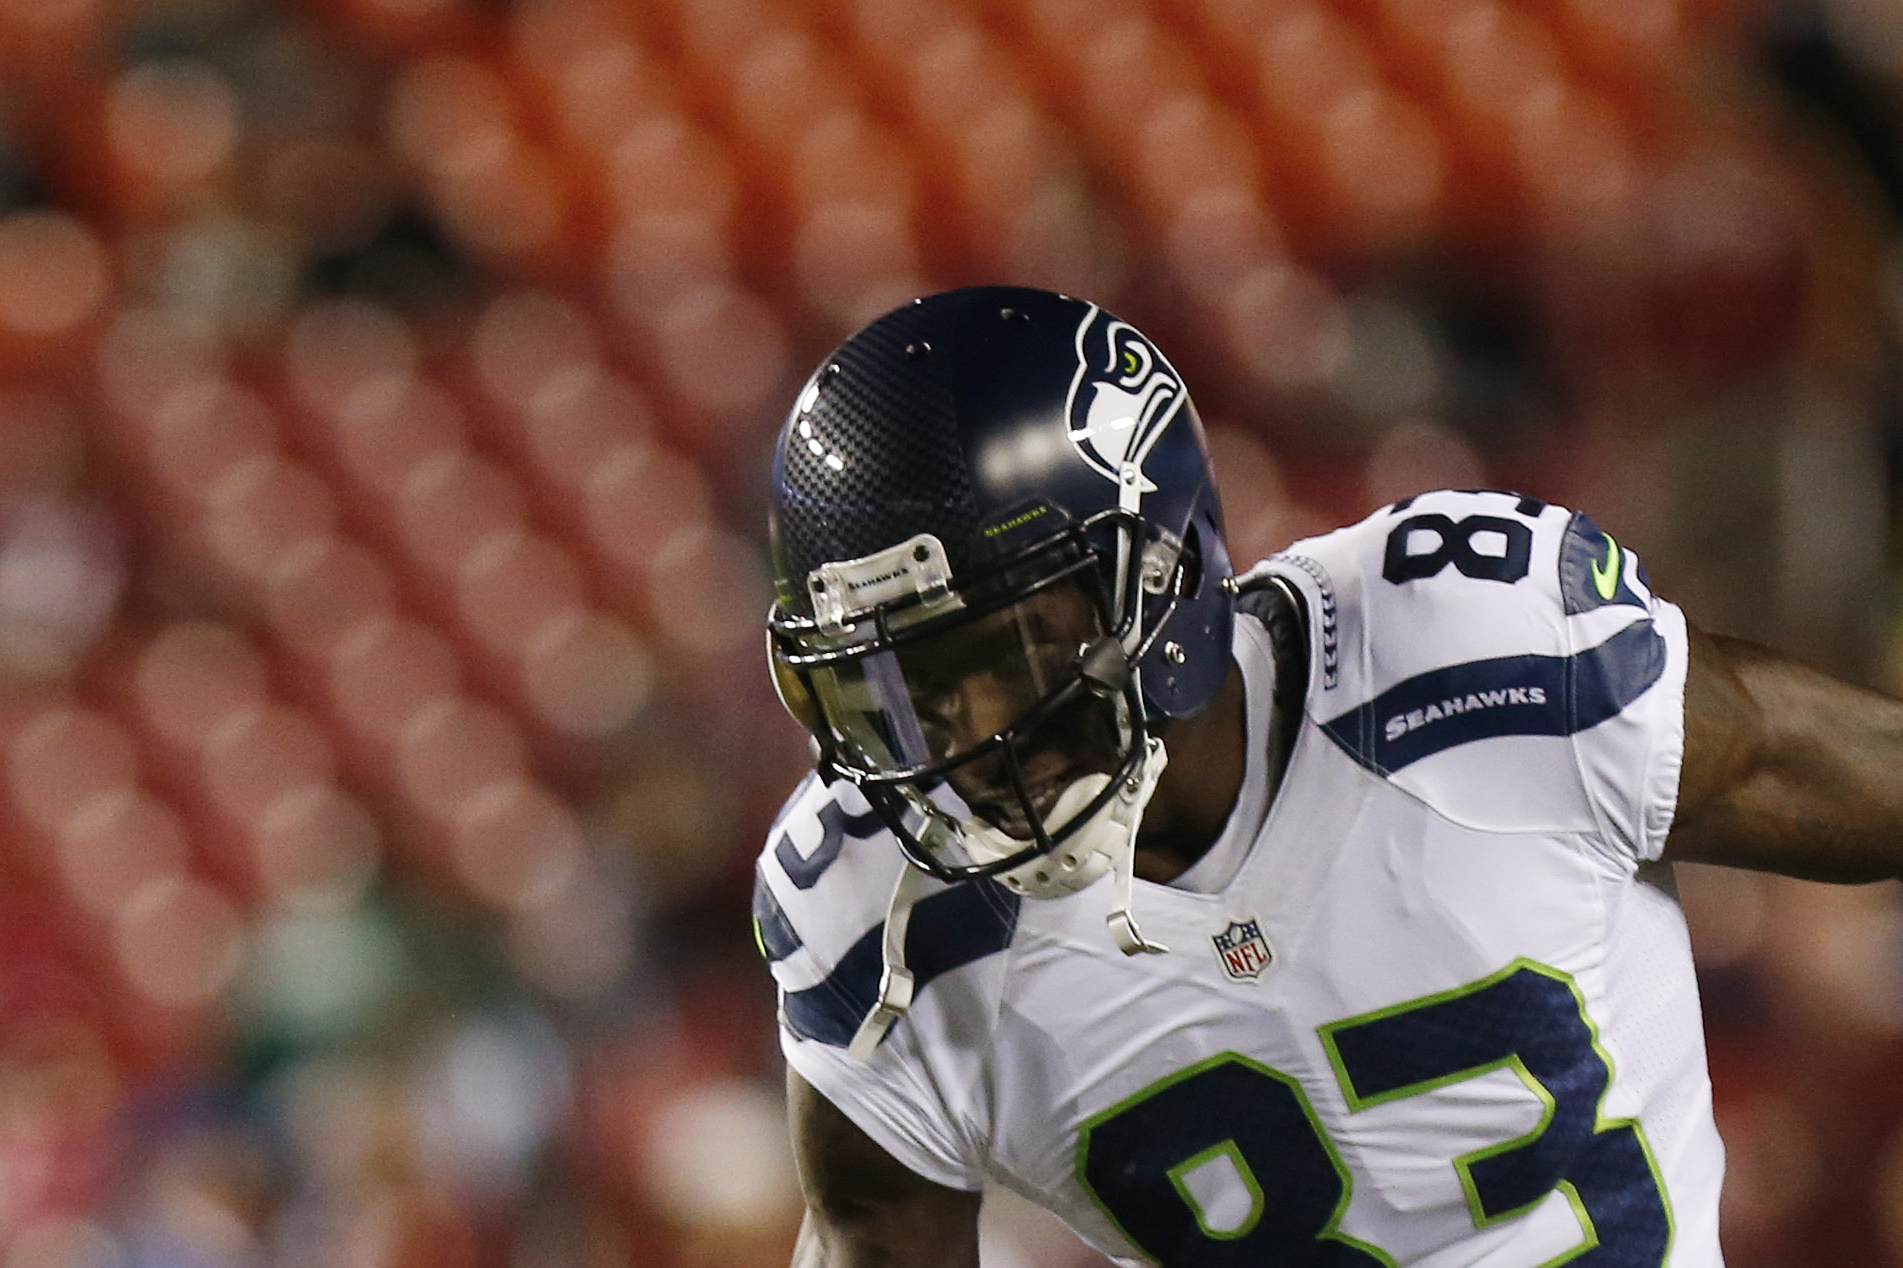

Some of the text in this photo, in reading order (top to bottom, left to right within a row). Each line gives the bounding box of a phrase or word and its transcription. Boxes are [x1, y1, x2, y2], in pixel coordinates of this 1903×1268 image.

[1382, 488, 1547, 586] 8
[1385, 687, 1547, 742] SEAHAWKS
[1225, 941, 1268, 974] NFL
